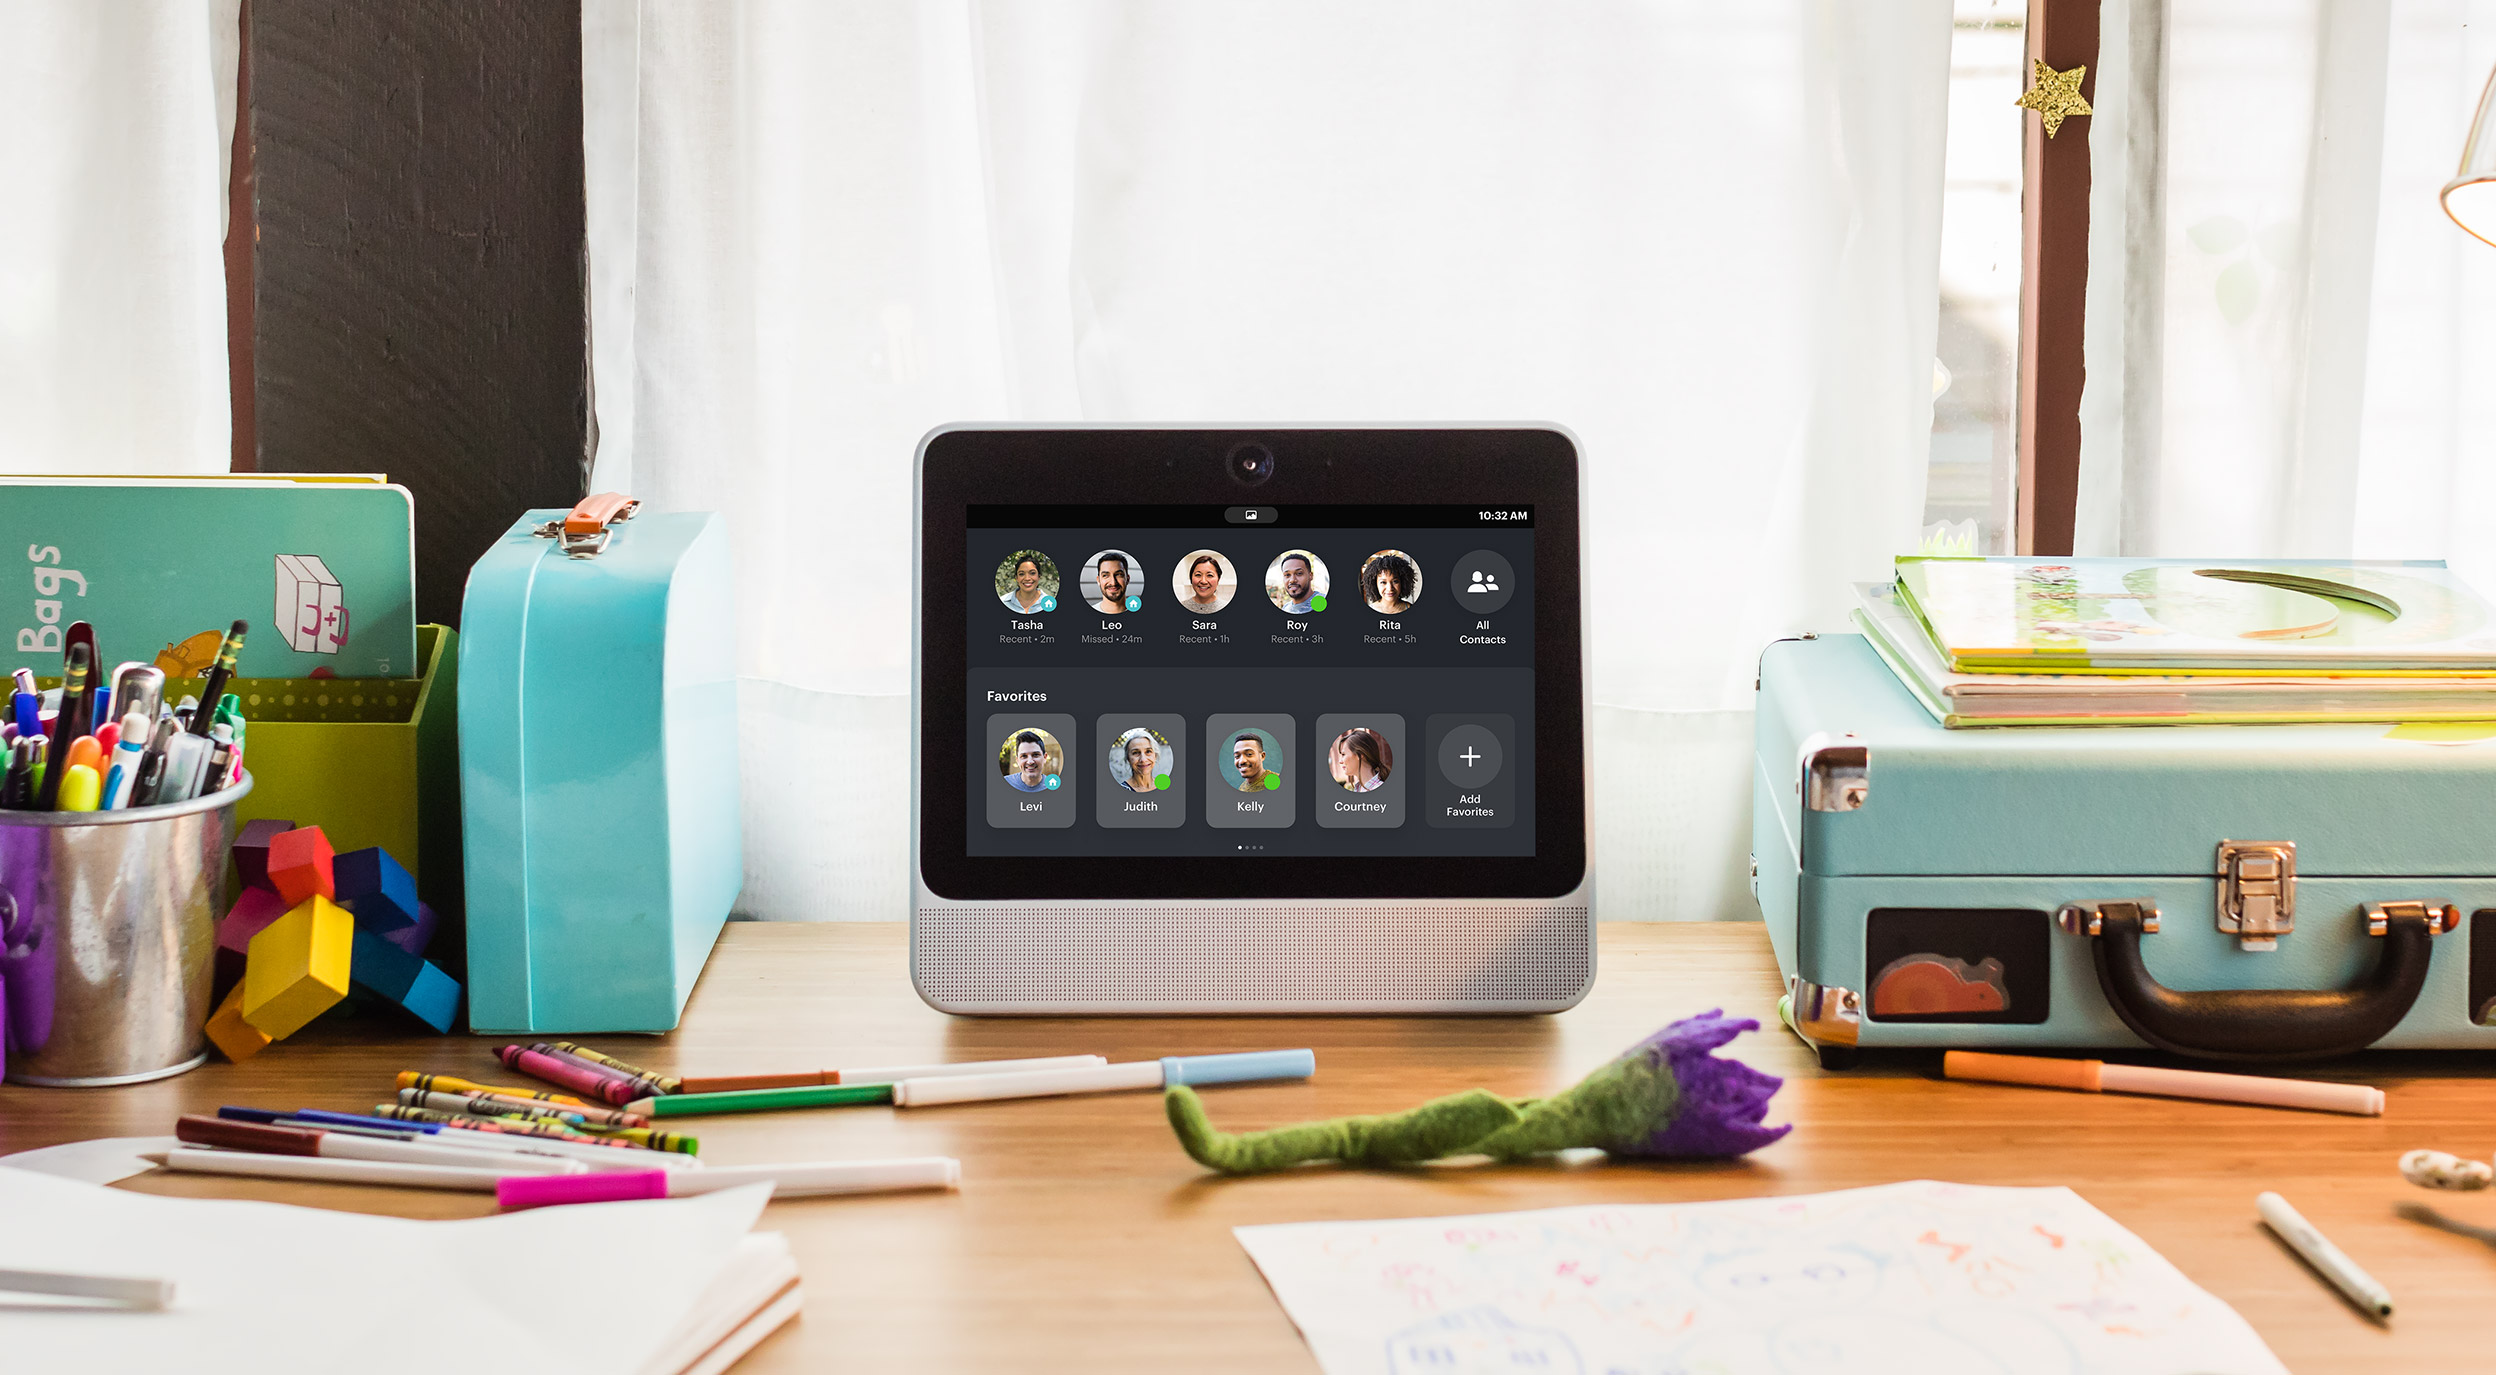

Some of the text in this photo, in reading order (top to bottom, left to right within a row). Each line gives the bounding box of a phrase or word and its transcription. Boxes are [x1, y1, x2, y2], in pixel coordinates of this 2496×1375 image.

[1478, 510, 1528, 521] 10:32 AM
[17, 544, 87, 652] Bags
[1010, 619, 1044, 630] Tasha
[1101, 619, 1123, 630] Leo
[1191, 619, 1217, 630] Sara
[1286, 619, 1309, 633] Roy
[1379, 619, 1401, 630] Rita
[1475, 619, 1490, 630] All
[999, 634, 1055, 644] Recent 2m
[1081, 634, 1143, 644] Missed 24m
[1179, 634, 1230, 644] Recent 1h
[1271, 634, 1324, 644] Recent 3h
[1363, 634, 1417, 644] Recent 5h
[1459, 634, 1507, 645] Contacts
[987, 690, 1048, 702] Favorites
[1459, 794, 1481, 804] Add
[1020, 801, 1043, 812] Levi
[1123, 800, 1158, 812] Judith
[1237, 801, 1265, 814] Kelly
[1334, 801, 1387, 815] Courtney
[1446, 806, 1495, 817] Favorites
